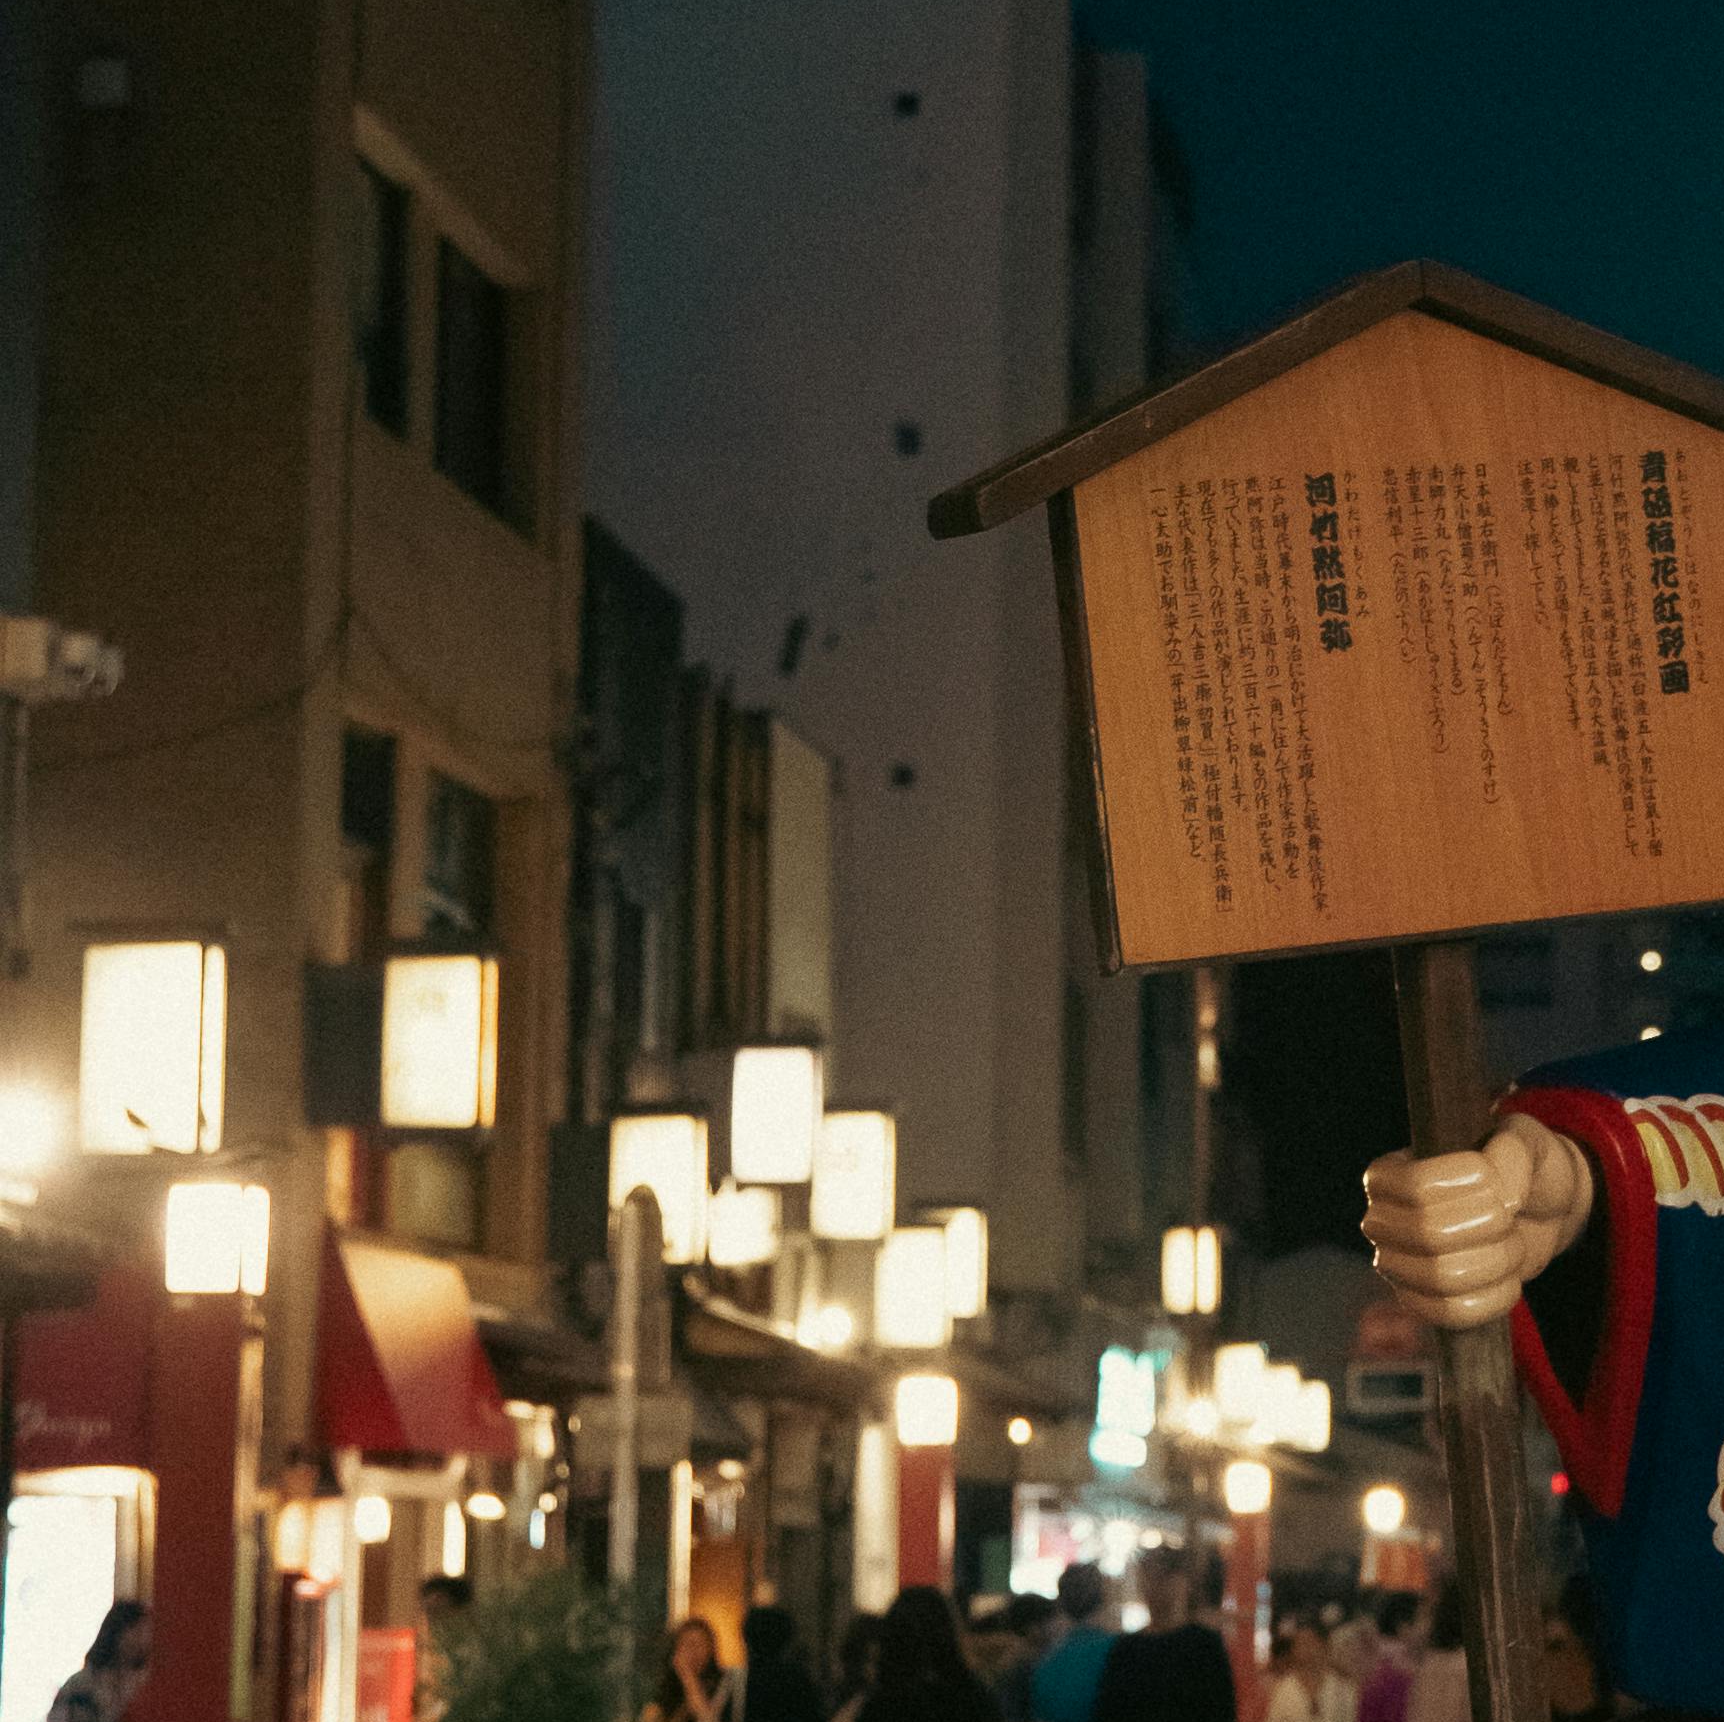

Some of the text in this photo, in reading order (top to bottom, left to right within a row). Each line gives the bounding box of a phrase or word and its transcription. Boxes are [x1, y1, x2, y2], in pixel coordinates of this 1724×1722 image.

[1304, 472, 1353, 653] 河竹黙阿弥
